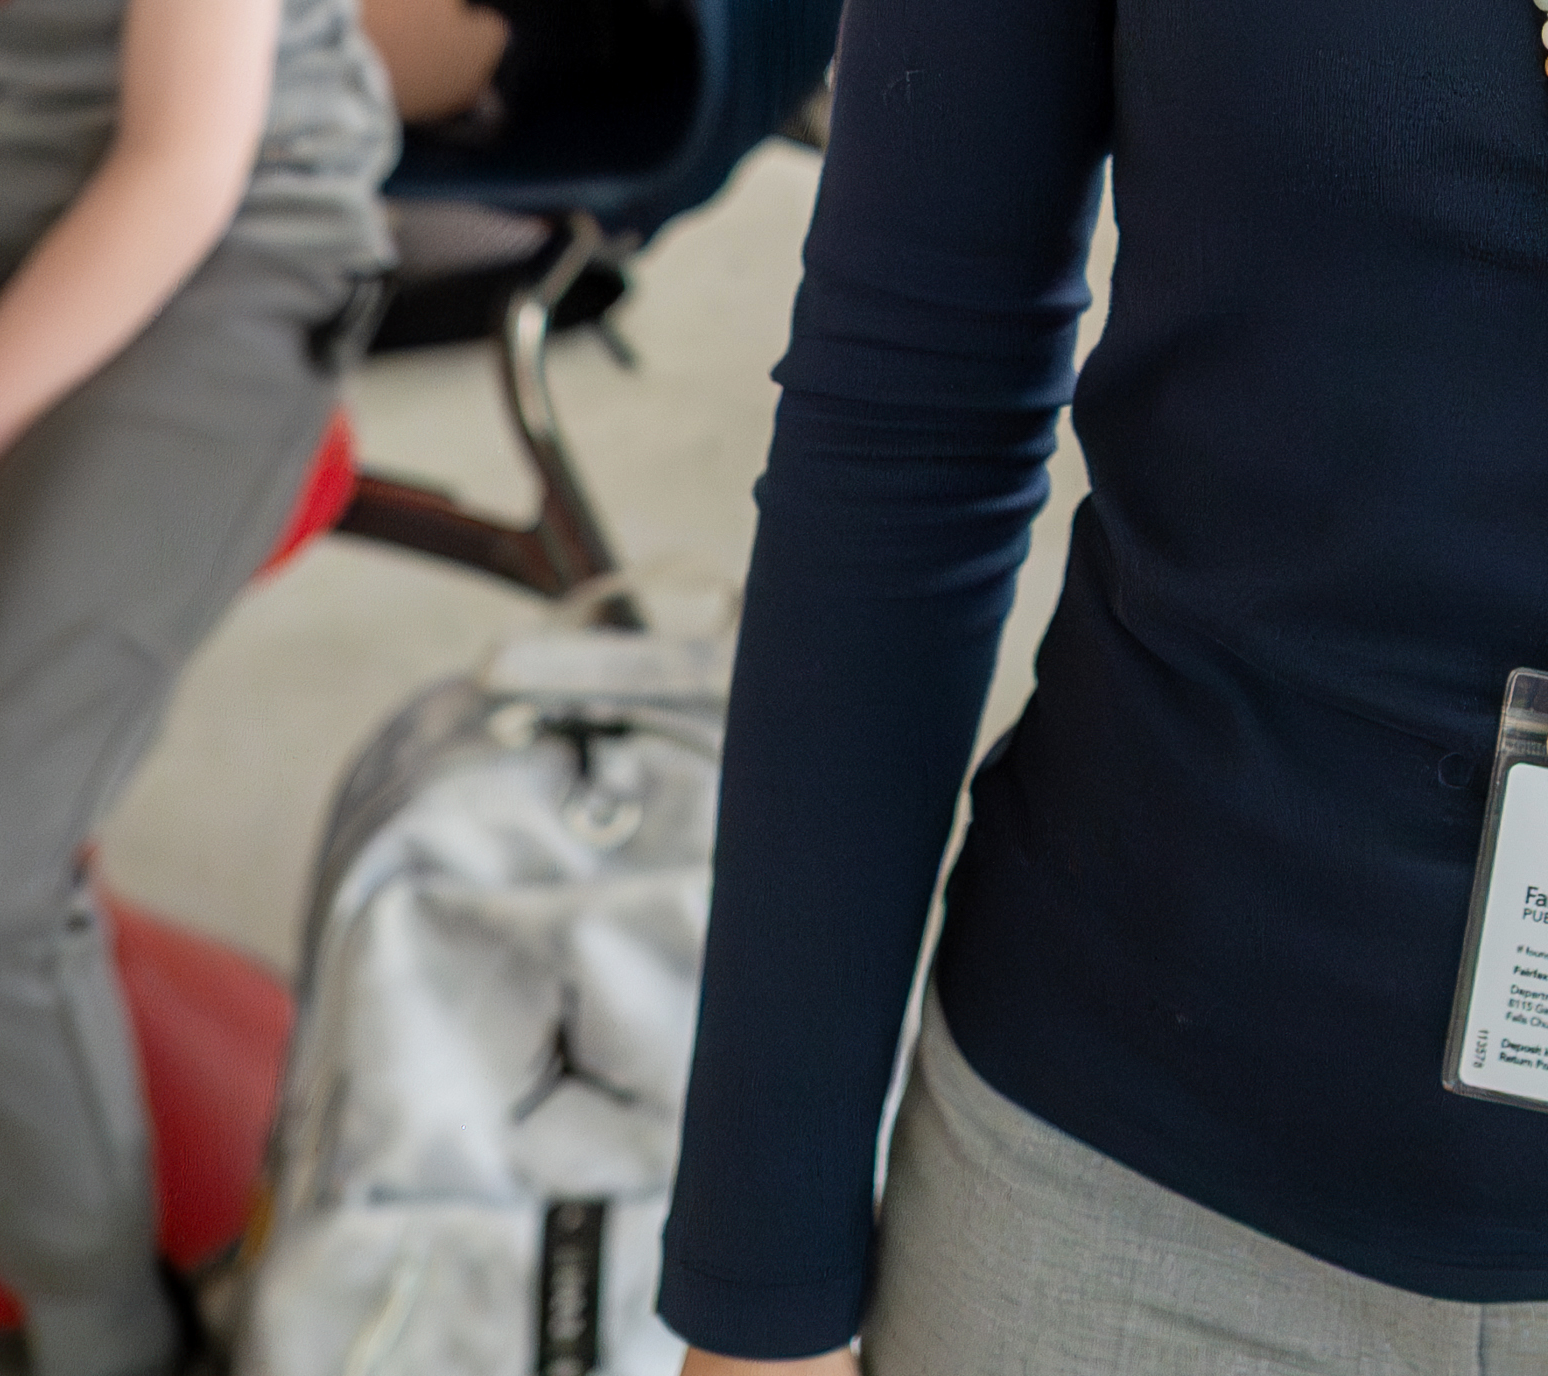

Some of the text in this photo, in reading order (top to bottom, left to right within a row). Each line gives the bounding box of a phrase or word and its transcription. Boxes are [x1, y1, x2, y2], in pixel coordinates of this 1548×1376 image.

[1513, 965, 1548, 981] Fairfax
[1505, 1011, 1528, 1025] Falls
[1501, 1038, 1541, 1055] Deposit
[1499, 1052, 1533, 1068] Return
